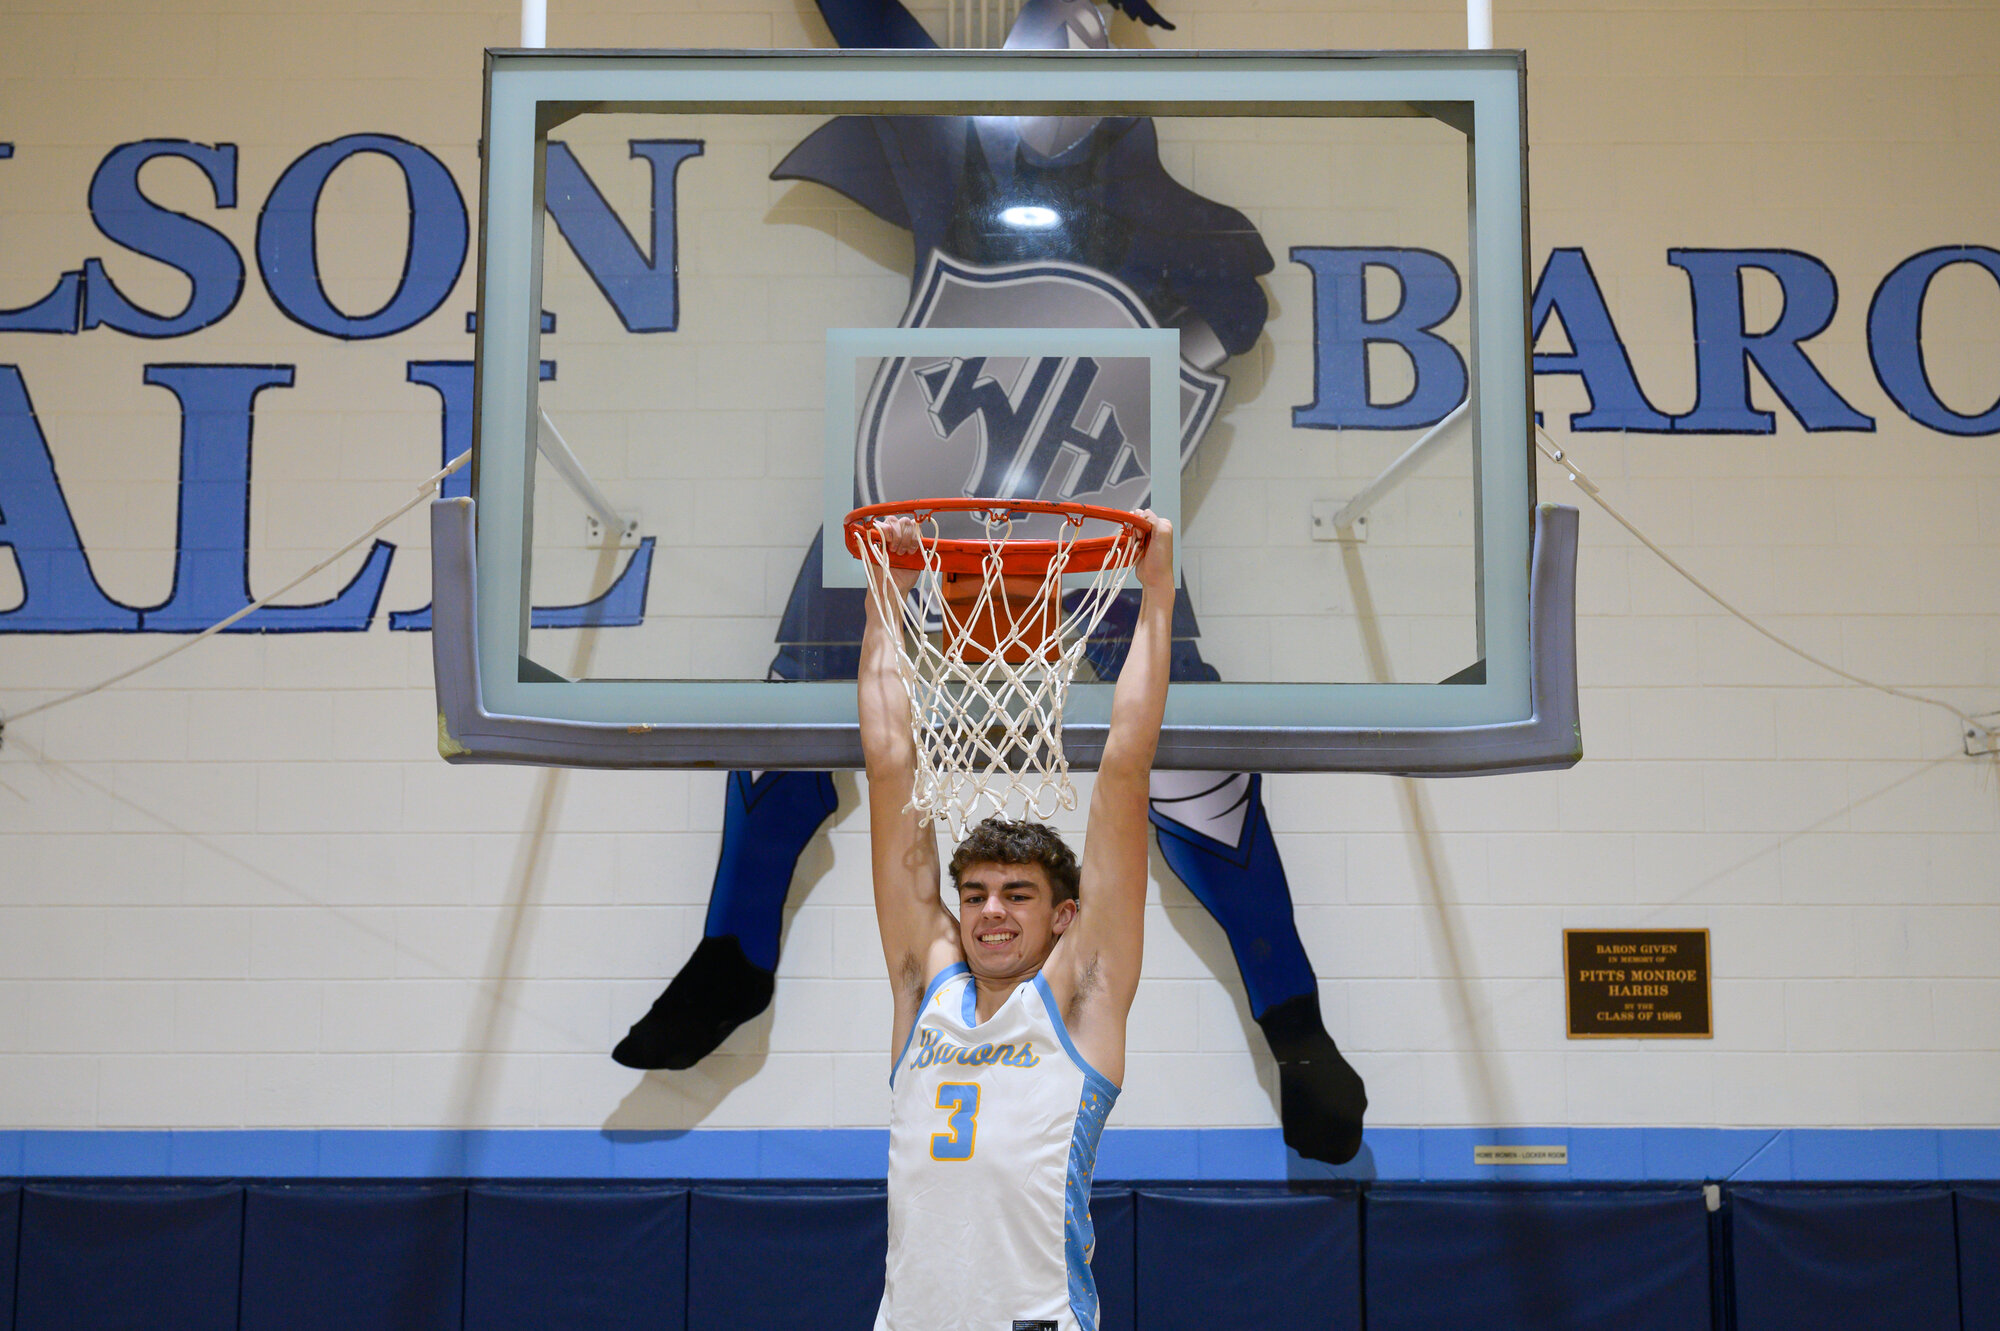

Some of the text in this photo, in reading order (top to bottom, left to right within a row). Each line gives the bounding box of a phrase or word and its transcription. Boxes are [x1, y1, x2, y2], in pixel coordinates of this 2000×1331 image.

[0, 132, 704, 341] SON
[1596, 944, 1678, 954] BARON GIVEN
[1579, 969, 1697, 982] PITTS MONROE
[1608, 984, 1669, 997] HARRIS
[1596, 1011, 1635, 1021] CLASS
[1637, 1011, 1653, 1021] OF
[910, 1028, 1040, 1071] Barons
[930, 1081, 981, 1161] 3
